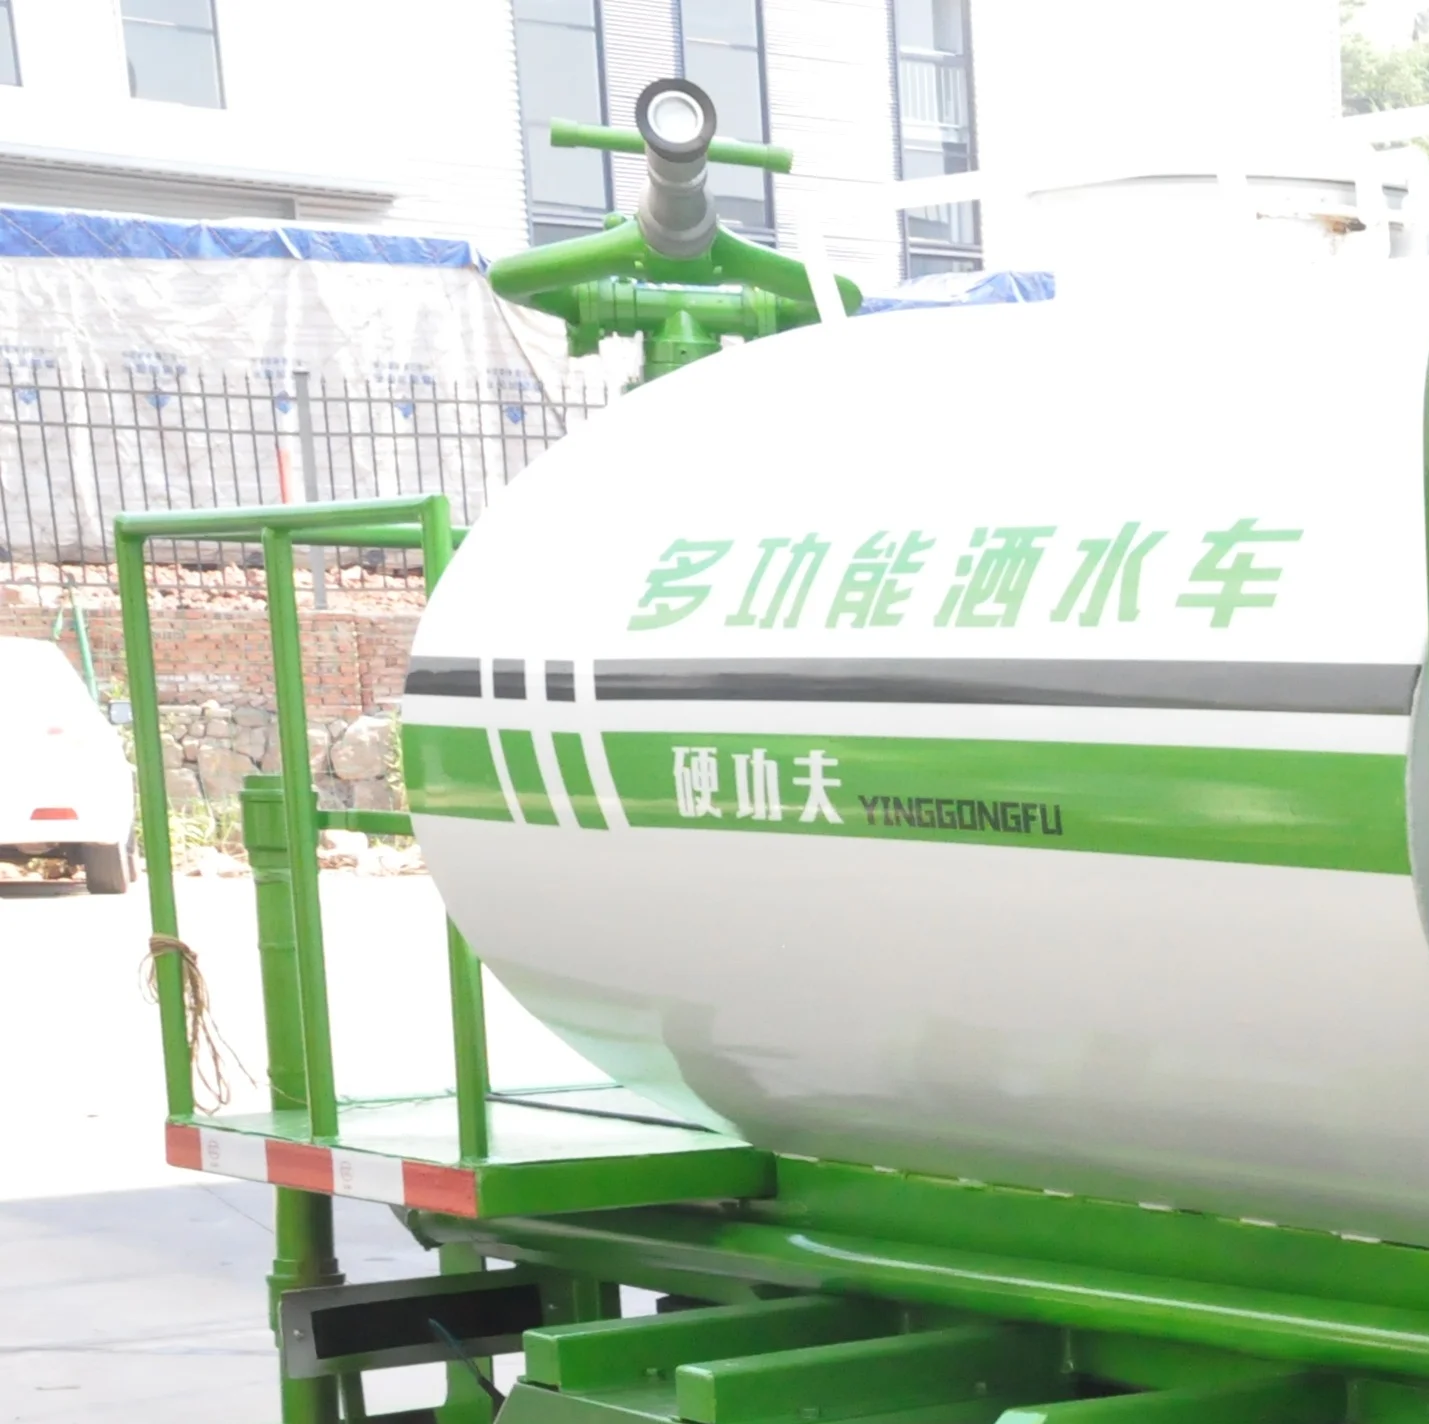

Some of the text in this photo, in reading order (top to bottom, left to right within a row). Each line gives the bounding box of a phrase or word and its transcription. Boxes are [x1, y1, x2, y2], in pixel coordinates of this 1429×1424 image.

[627, 518, 1304, 631] 多功能洒水车
[672, 746, 1063, 836] 硬功夫 YINGGONGFU
